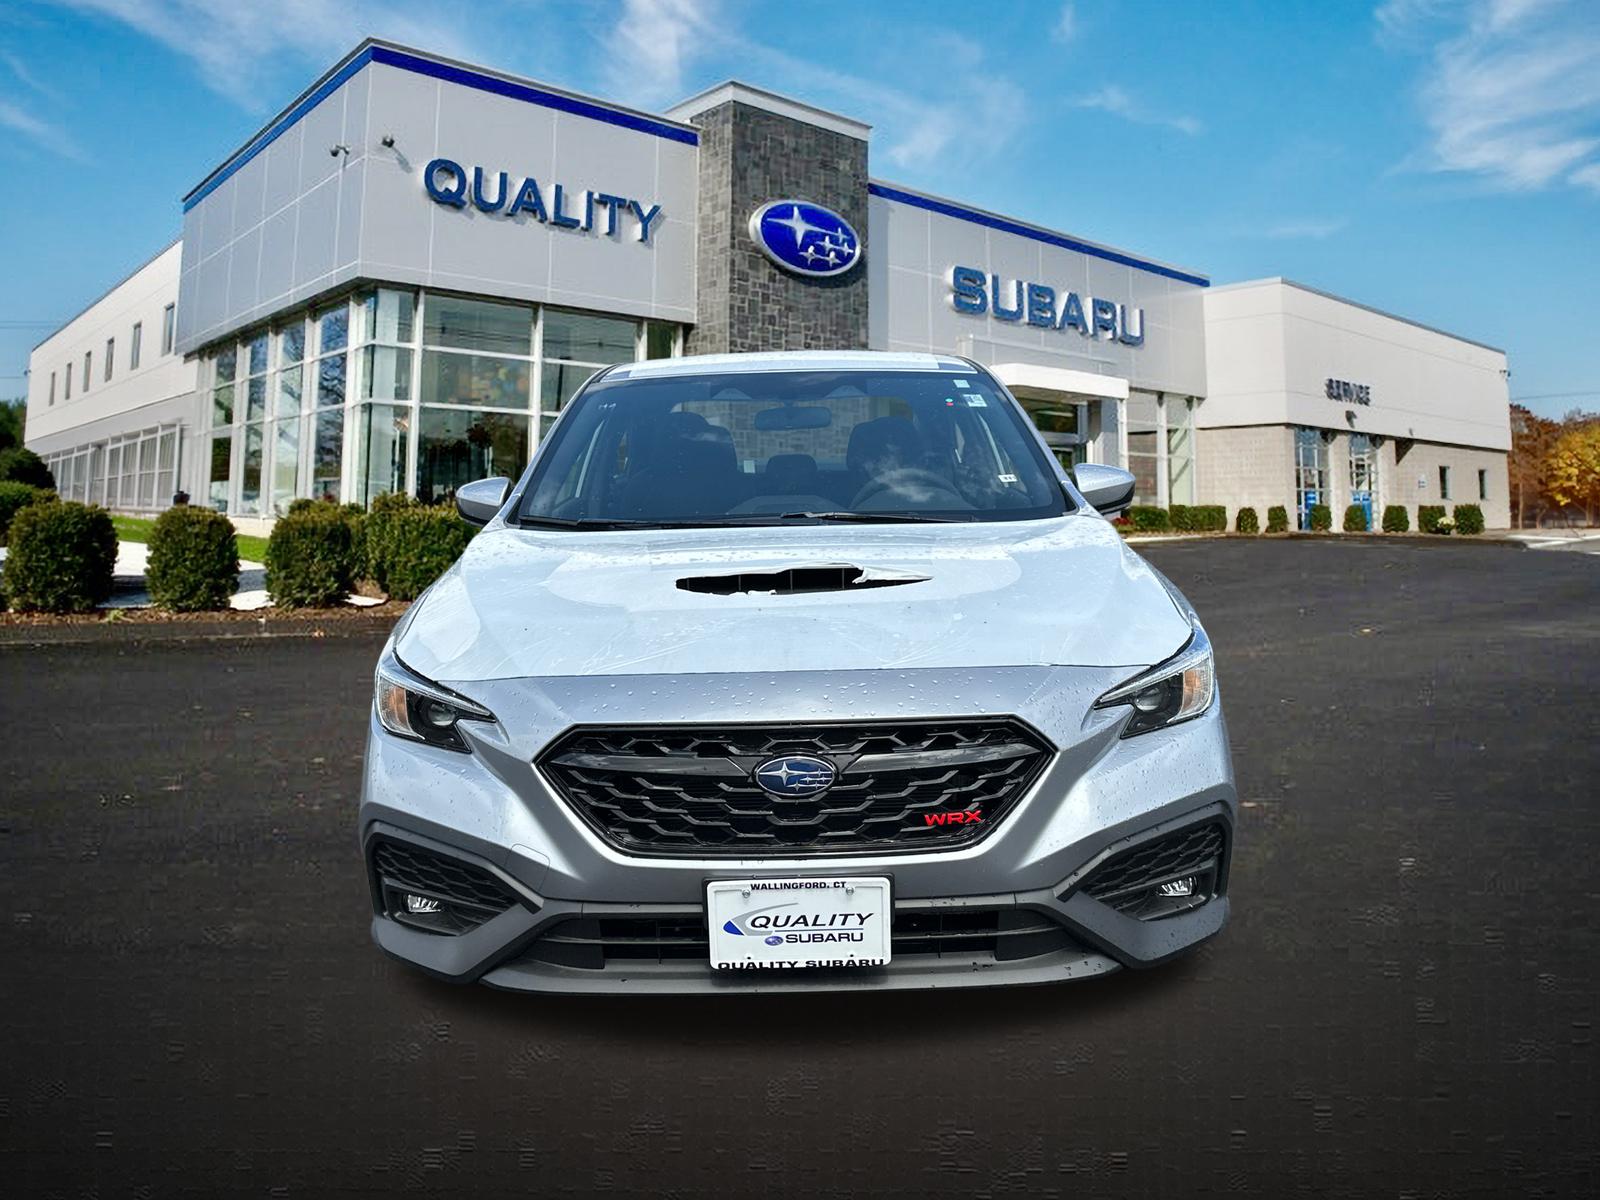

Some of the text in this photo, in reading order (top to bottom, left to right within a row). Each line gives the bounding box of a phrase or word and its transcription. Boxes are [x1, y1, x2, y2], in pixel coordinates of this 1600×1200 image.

[424, 158, 661, 243] QUALITY
[951, 265, 1145, 346] SUBARU
[924, 810, 982, 826] WRX
[833, 881, 847, 889] CT
[750, 912, 874, 928] QUALITY
[785, 932, 863, 943] SUBARU
[718, 959, 884, 969] QUALITY SUBARU
